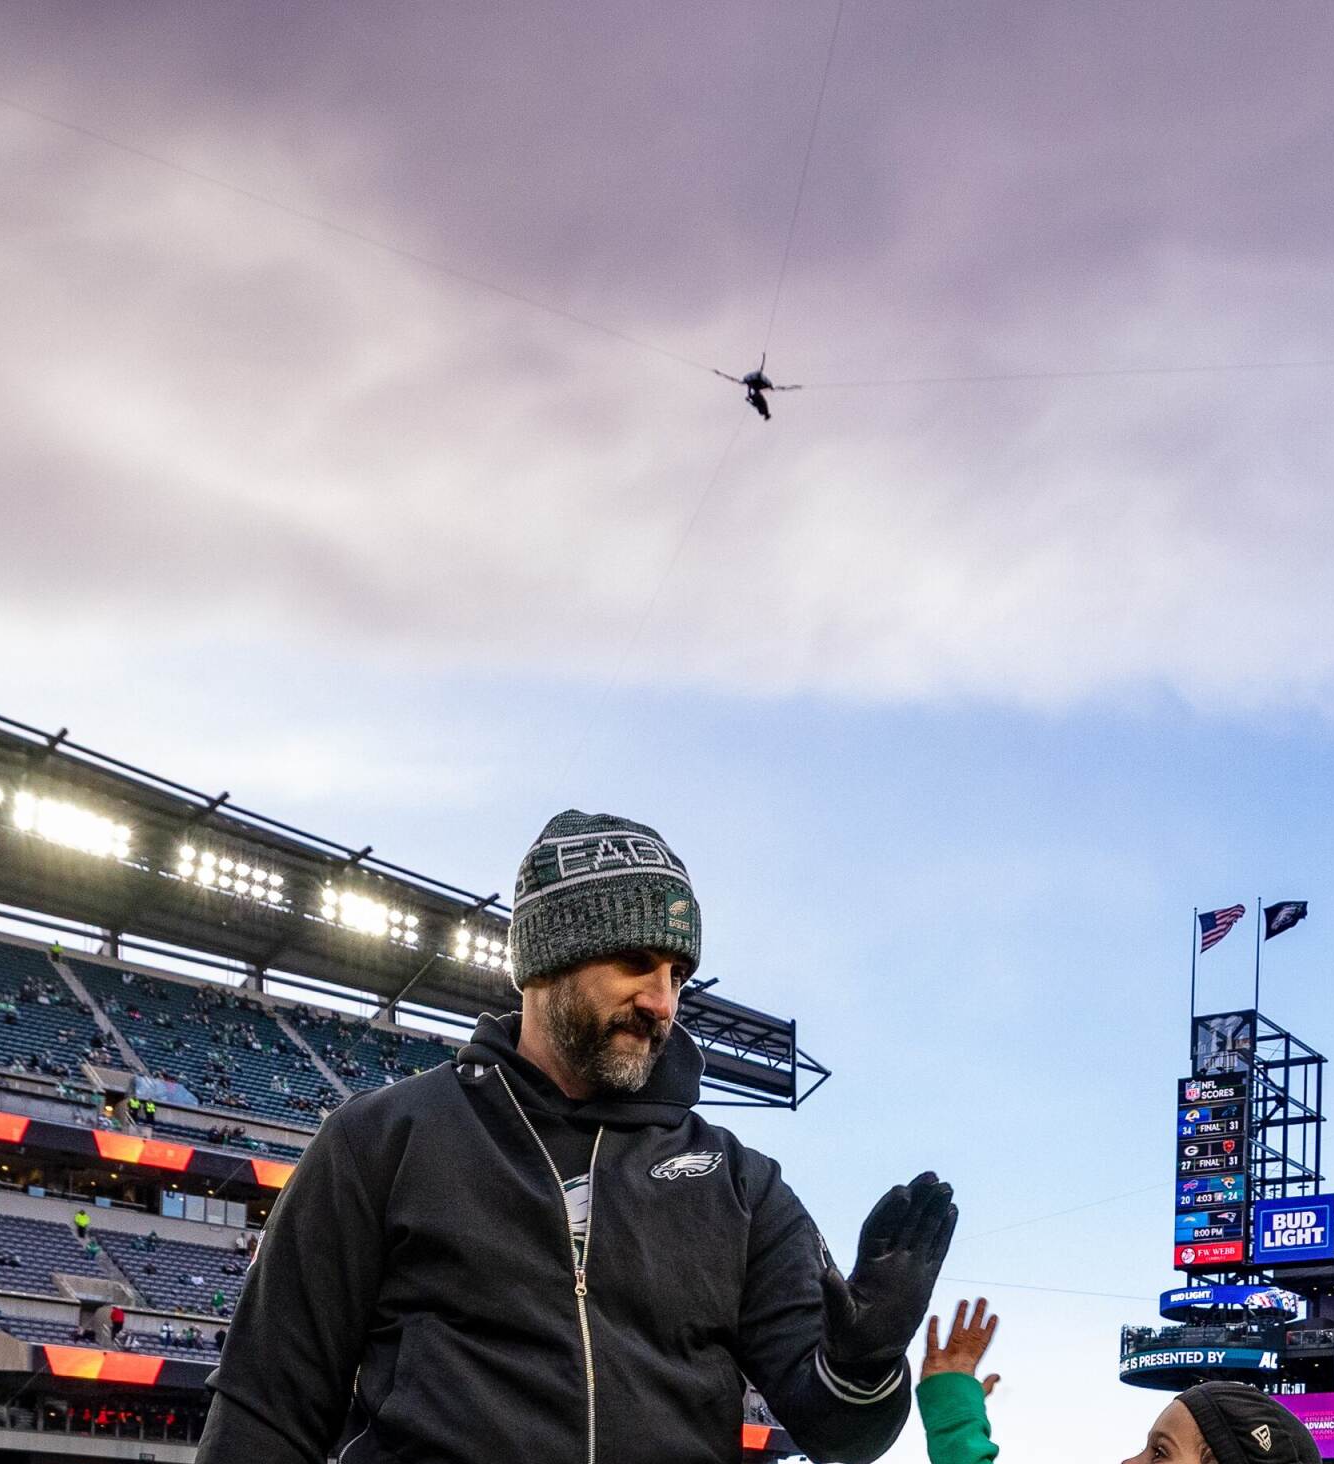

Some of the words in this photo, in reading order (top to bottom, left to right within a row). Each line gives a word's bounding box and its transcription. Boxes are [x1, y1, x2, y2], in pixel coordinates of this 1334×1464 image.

[1201, 1080, 1217, 1090] NFL
[1201, 1088, 1235, 1100] SCORES
[1200, 1121, 1222, 1132] FINAL
[1229, 1120, 1239, 1130] 31
[1181, 1160, 1191, 1170] 27
[1199, 1158, 1220, 1168] FINAL
[1228, 1156, 1238, 1165] 31
[1181, 1195, 1191, 1205] 20
[1272, 1211, 1317, 1231] BUD
[1211, 1227, 1223, 1237] PM
[1264, 1227, 1325, 1248] LIGHT
[1170, 1292, 1184, 1303] BUD
[1185, 1290, 1212, 1300] LIGHT
[1130, 1356, 1138, 1369] IS
[1138, 1351, 1204, 1367] PRESENTED
[1207, 1351, 1226, 1364] BY
